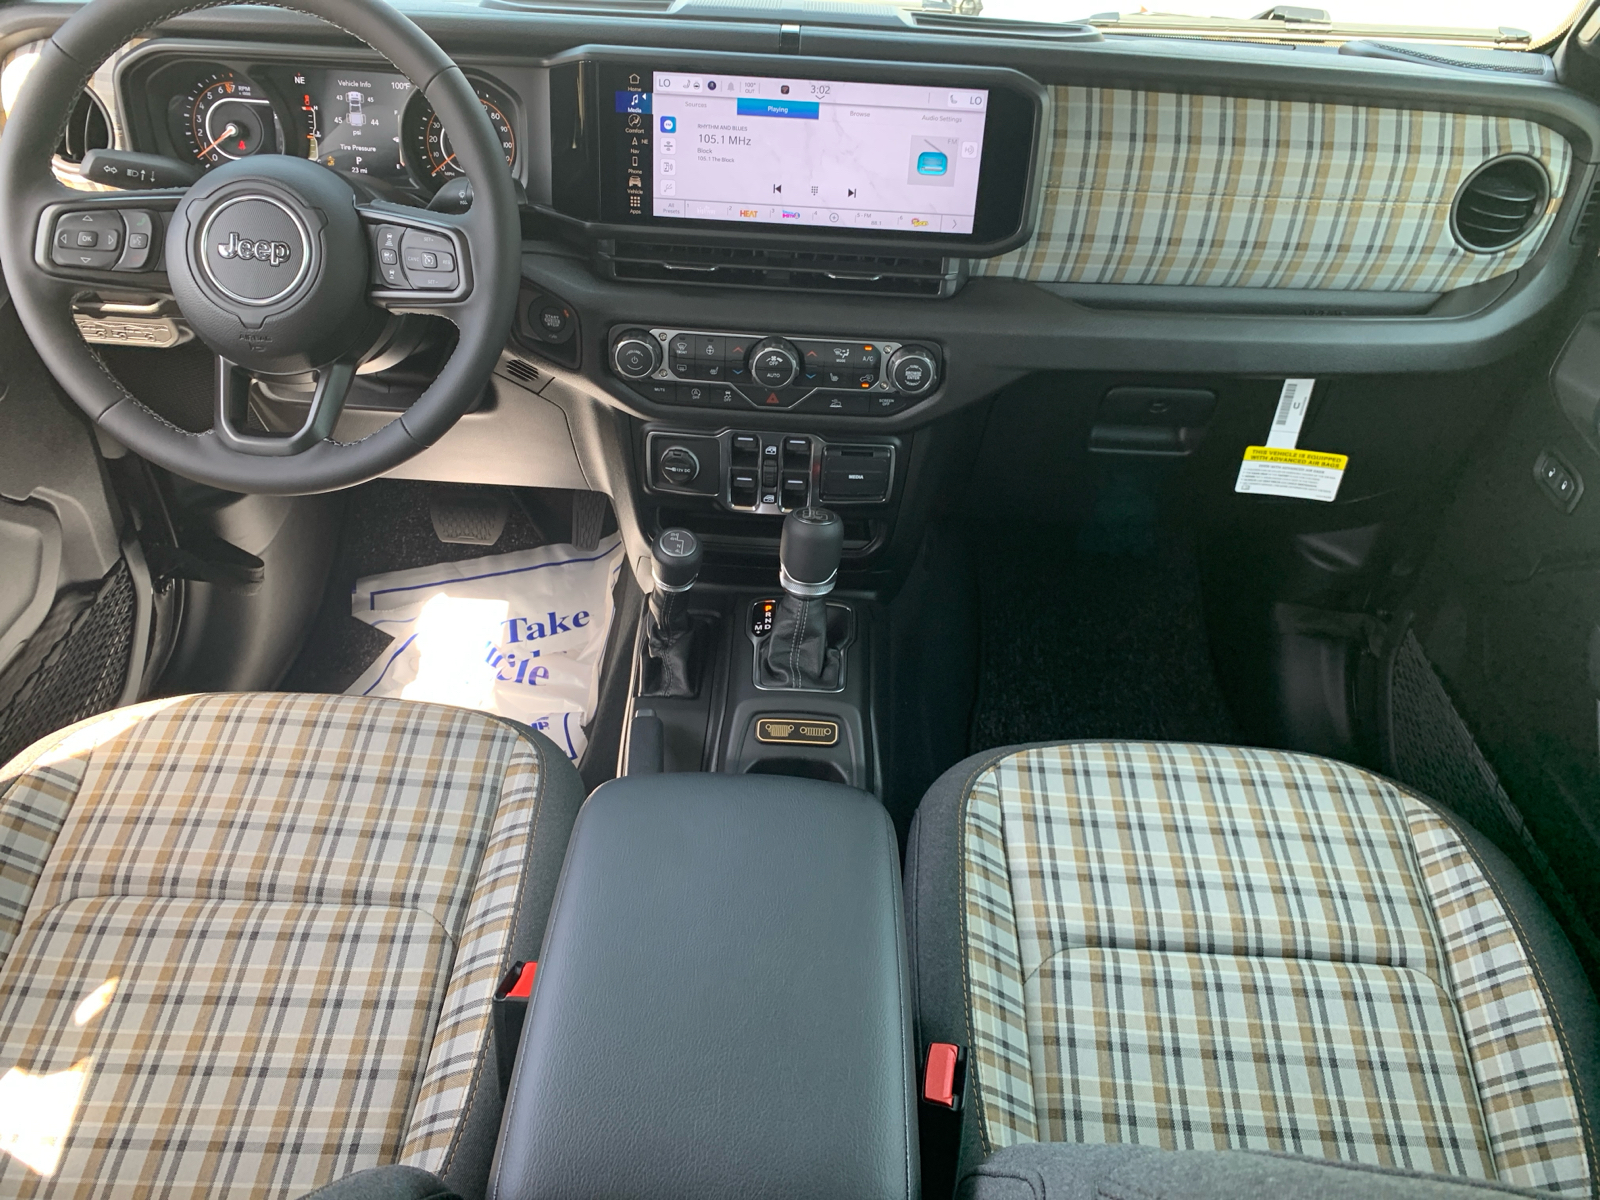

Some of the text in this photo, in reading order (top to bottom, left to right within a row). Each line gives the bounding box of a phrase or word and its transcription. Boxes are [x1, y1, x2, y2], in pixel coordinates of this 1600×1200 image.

[294, 76, 305, 85] NE
[337, 79, 359, 87] Vehicle
[658, 79, 671, 88] LO
[218, 86, 224, 94] 6
[810, 85, 830, 94] 3:02
[207, 92, 213, 100] 5
[685, 101, 707, 109] Sources
[969, 96, 983, 106] LO
[767, 106, 788, 114] Playing
[850, 110, 871, 118] Browse
[196, 115, 202, 123] 3
[490, 112, 501, 120] 80
[921, 114, 963, 124] Audio Settings
[697, 123, 719, 131] RHYTHM
[197, 129, 203, 137] 2
[429, 135, 438, 143] 20
[698, 133, 752, 146] 105.1 MHz
[211, 154, 218, 162] 0
[355, 156, 363, 165] P
[739, 209, 759, 218] HEAT
[217, 231, 291, 267] Jeep
[1269, 450, 1297, 458] VEHICLE
[1306, 454, 1342, 463] EQUIPPED
[1270, 456, 1307, 465] ADVANCED
[1321, 461, 1340, 469] BAGS
[500, 610, 590, 645] Take
